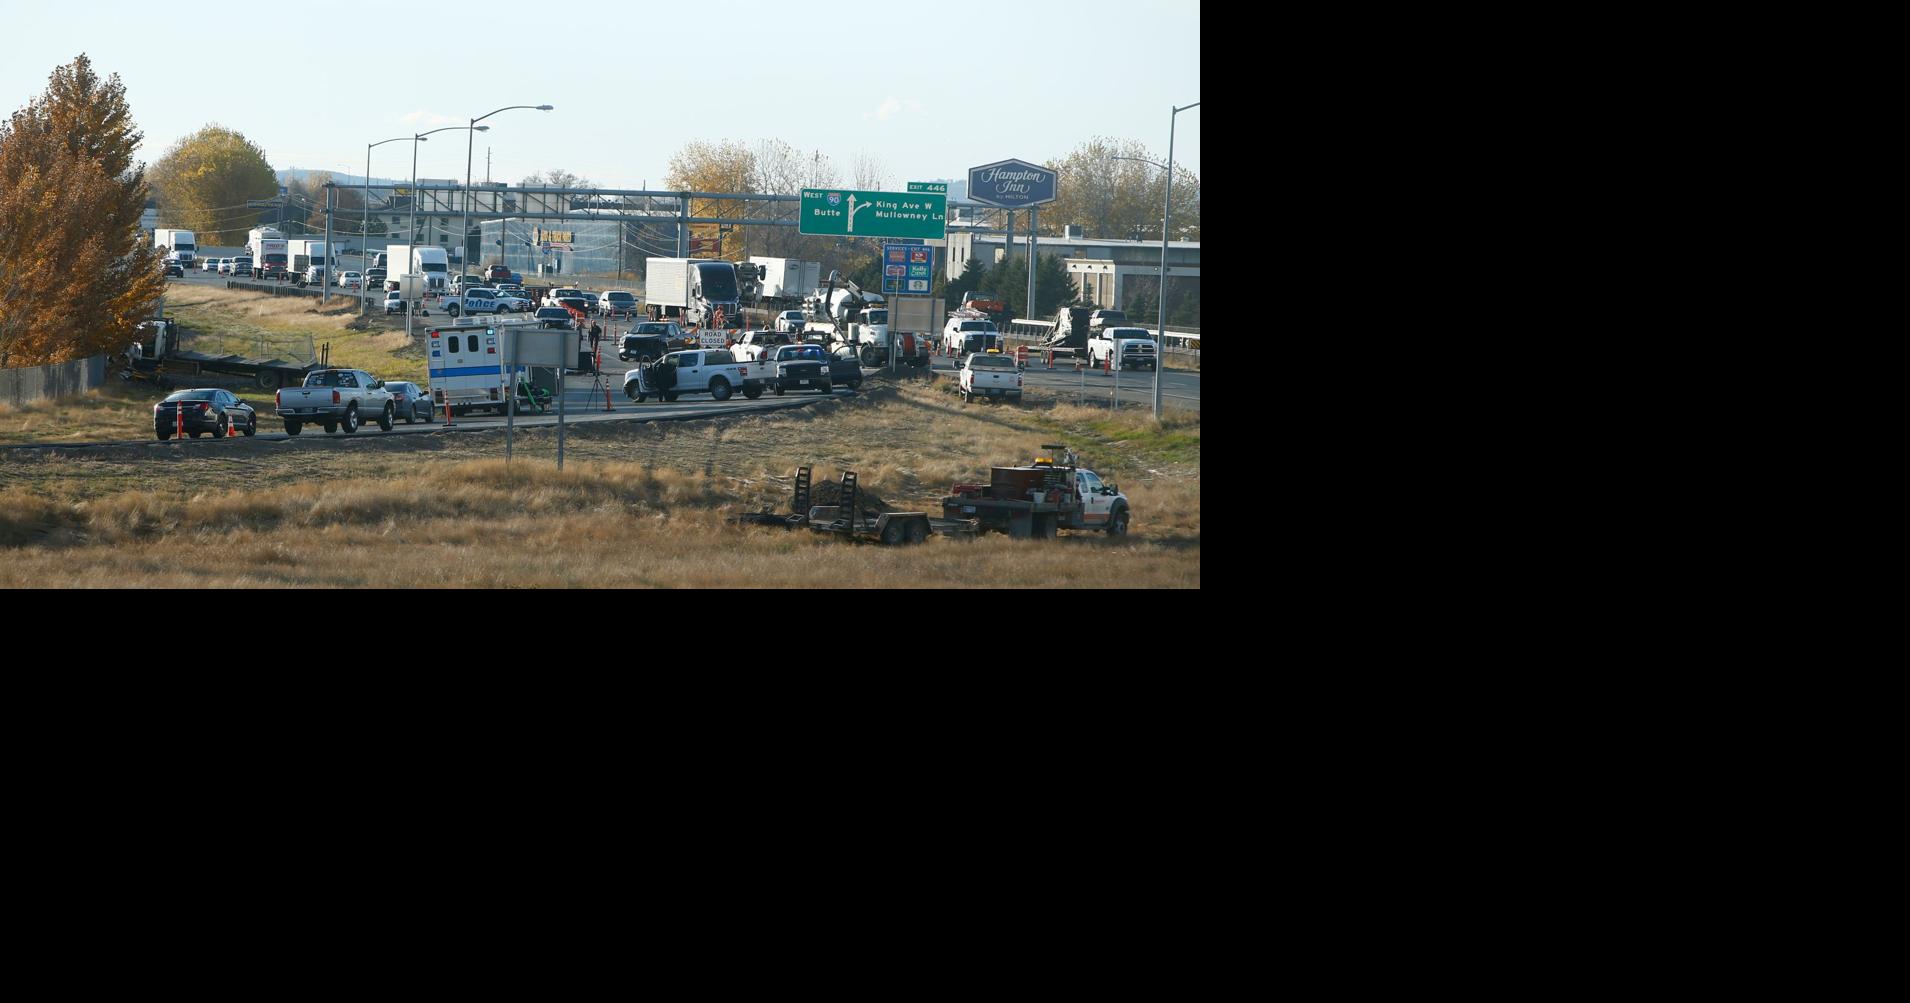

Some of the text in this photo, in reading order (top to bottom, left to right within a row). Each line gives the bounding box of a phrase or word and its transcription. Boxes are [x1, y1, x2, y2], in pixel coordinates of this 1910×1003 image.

[981, 168, 1046, 183] Hampton
[927, 184, 945, 192] 446
[996, 180, 1030, 194] Inn
[803, 191, 823, 199] WEST
[876, 200, 933, 210] King Ave W
[814, 208, 841, 217] Butte
[875, 210, 928, 221] Mullowney
